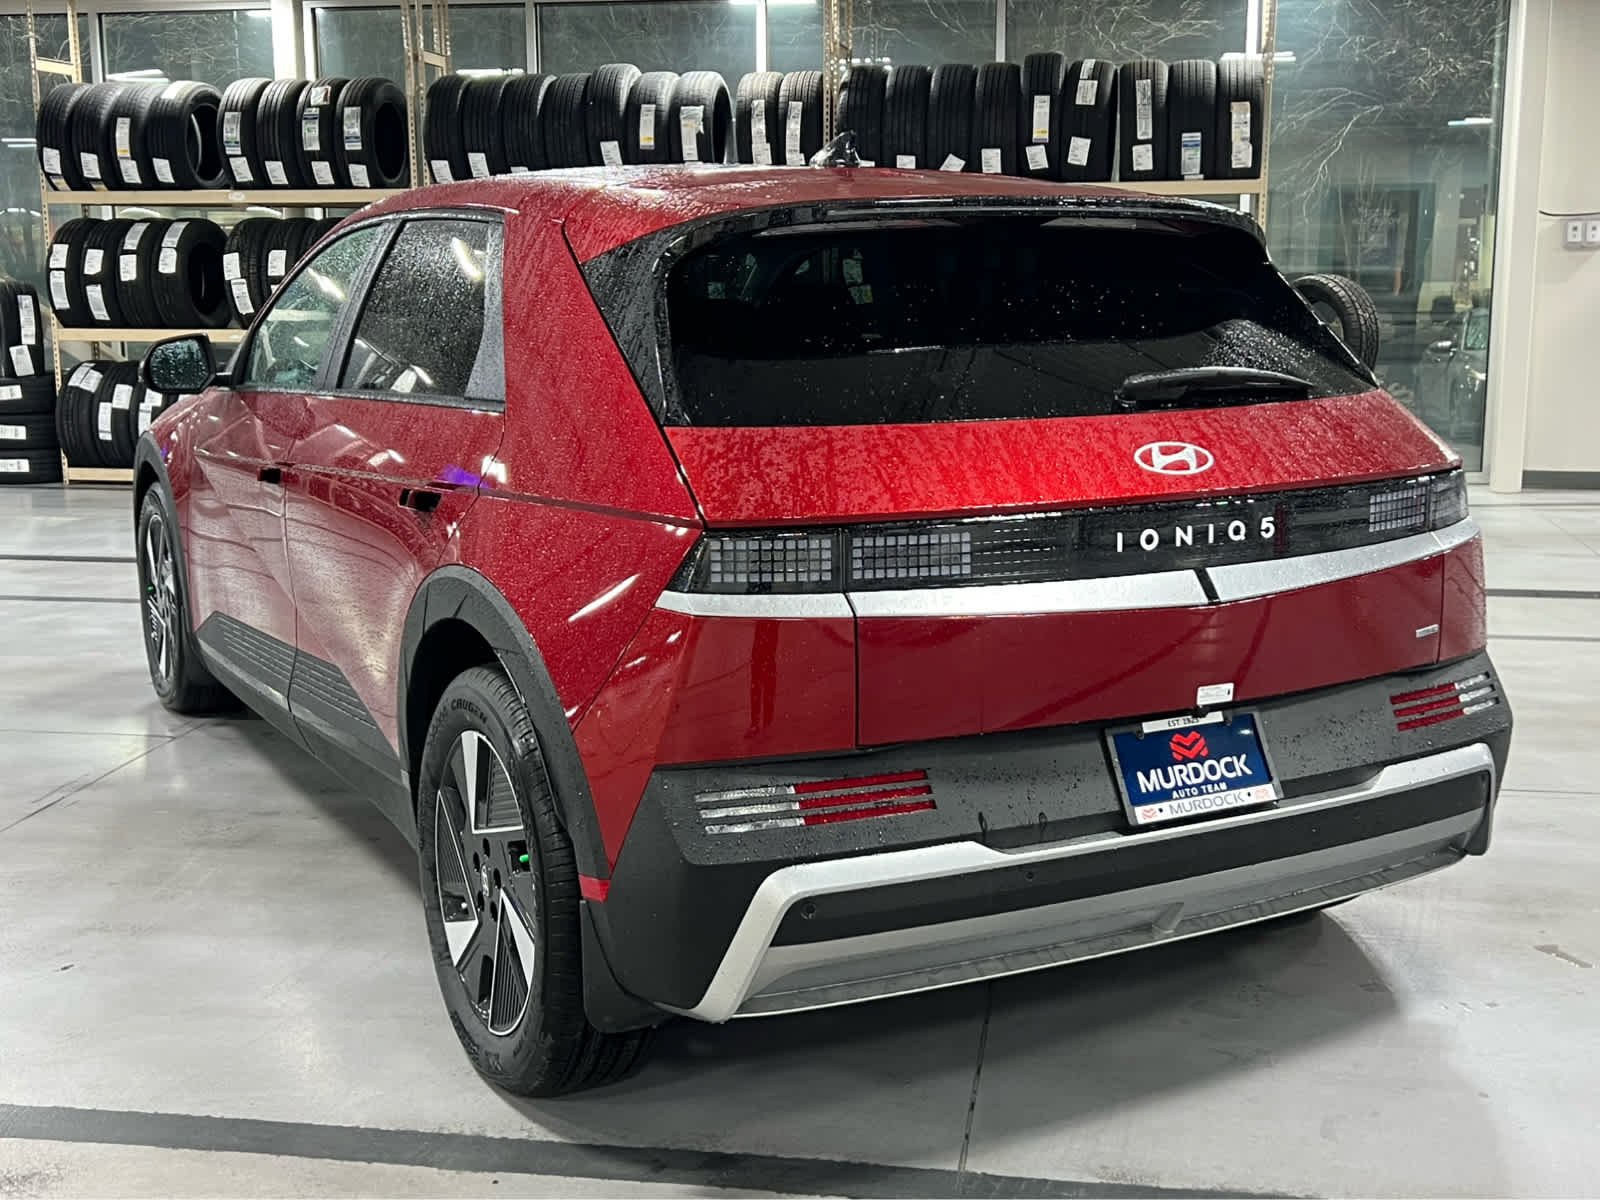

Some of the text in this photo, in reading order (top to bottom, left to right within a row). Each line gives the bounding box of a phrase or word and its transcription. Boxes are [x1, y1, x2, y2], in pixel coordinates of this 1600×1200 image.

[1136, 753, 1253, 793] MURDOCK
[1171, 781, 1228, 800] AUTO TEAM
[1168, 791, 1246, 816] MURDOCK
